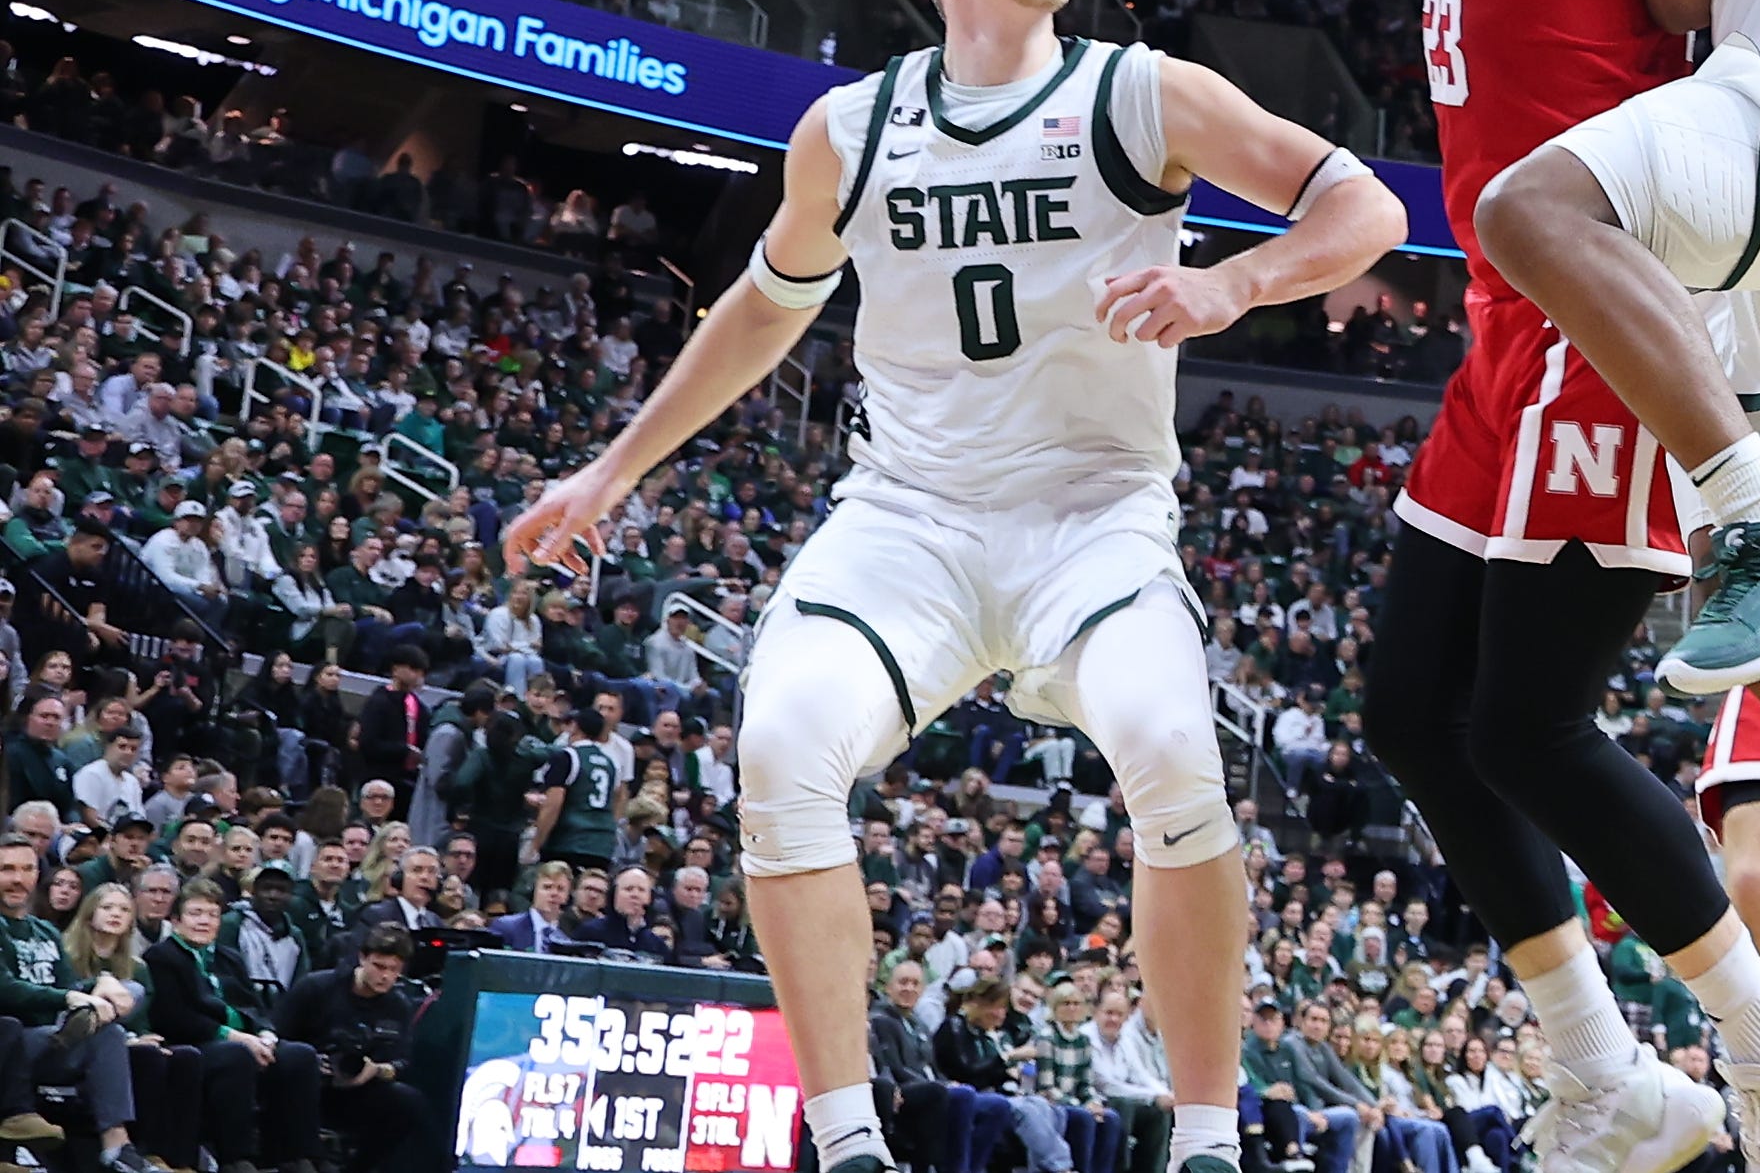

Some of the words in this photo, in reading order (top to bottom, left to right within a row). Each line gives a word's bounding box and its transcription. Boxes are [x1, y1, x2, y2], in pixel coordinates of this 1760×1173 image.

[513, 17, 688, 96] Families
[886, 175, 1082, 251] STATE
[952, 263, 1022, 362] 0
[1544, 419, 1625, 499] N
[588, 767, 611, 809] 3
[528, 993, 598, 1067] 35
[594, 1007, 696, 1077] 3:52
[694, 1007, 755, 1077] 22
[612, 1095, 665, 1141] 1ST
[740, 1083, 799, 1169] N
